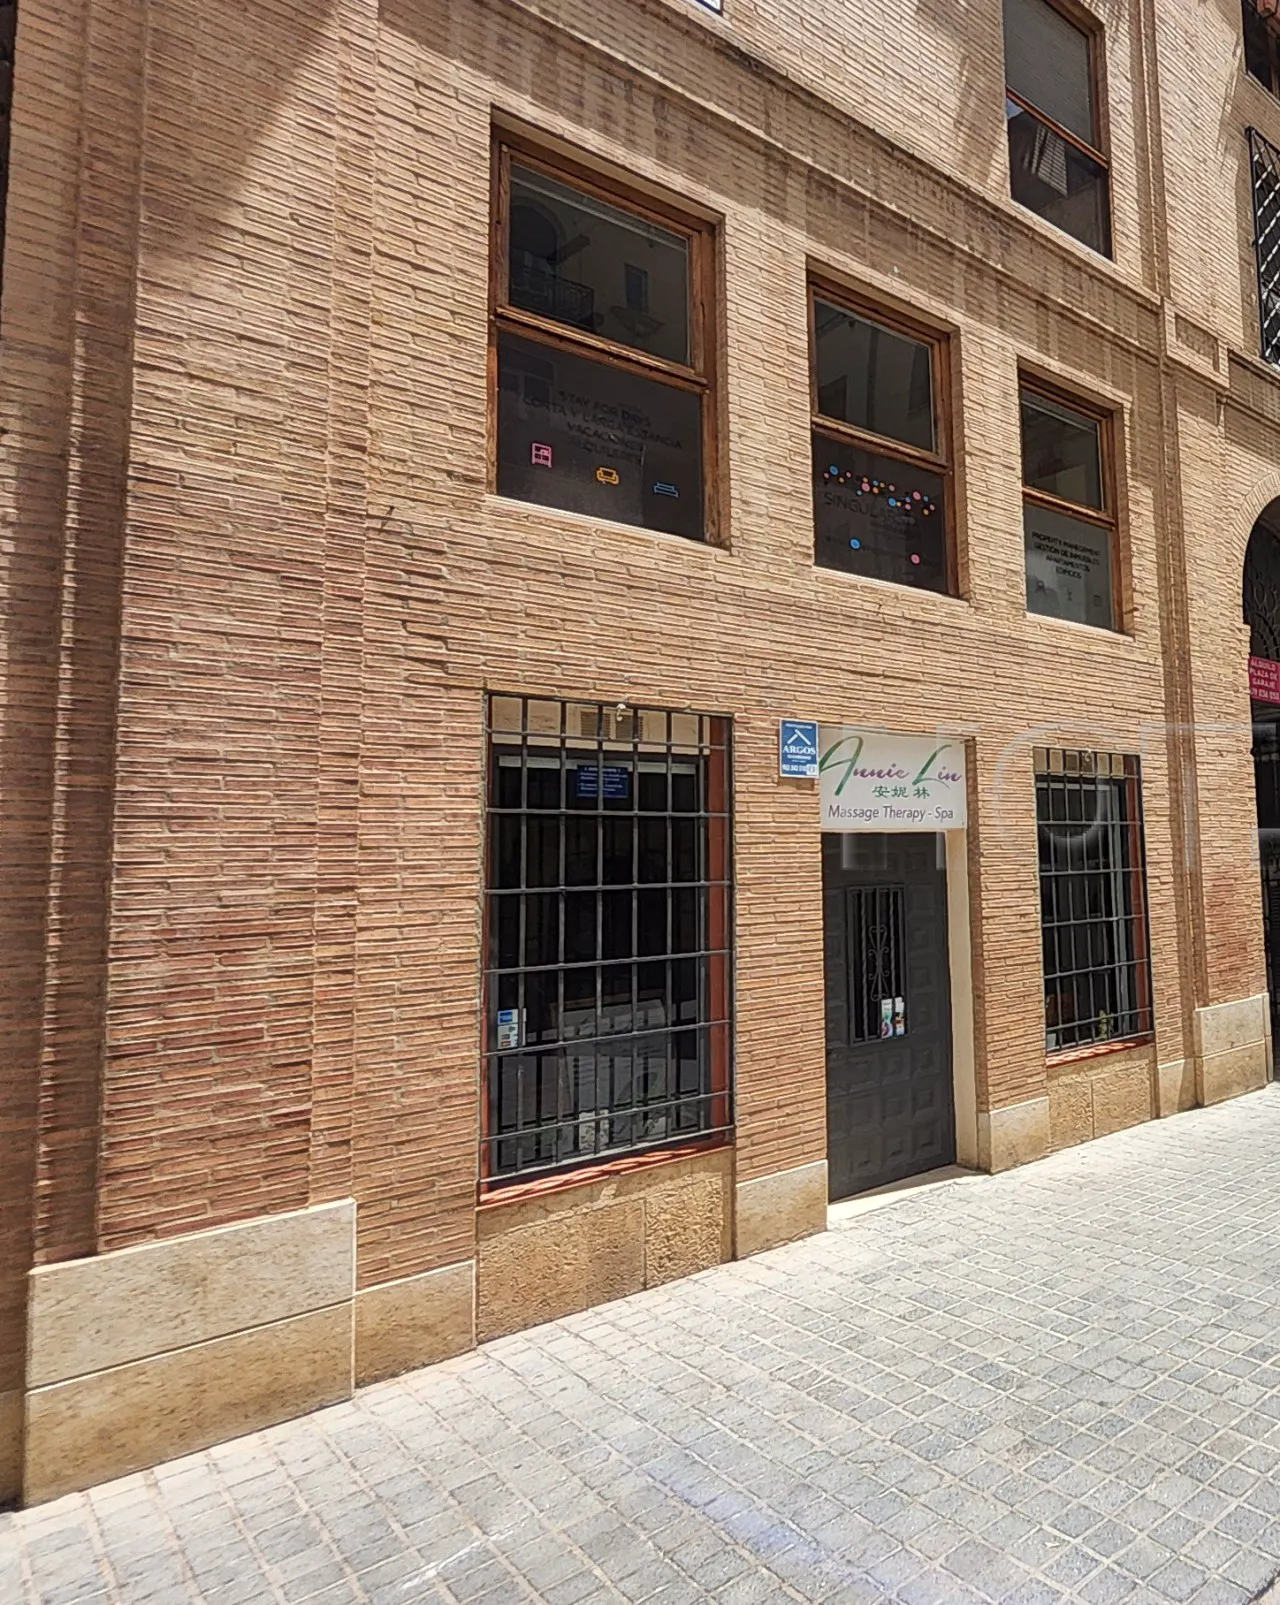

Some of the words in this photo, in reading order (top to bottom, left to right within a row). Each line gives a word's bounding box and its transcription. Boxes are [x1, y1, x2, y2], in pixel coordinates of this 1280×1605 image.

[559, 390, 590, 407] STAY
[595, 400, 619, 416] FOR
[1250, 667, 1270, 678] PLAZA
[782, 745, 816, 755] ARGOS
[819, 735, 910, 796] Annie
[911, 744, 962, 791] Lin
[828, 805, 880, 822] Massage
[883, 805, 926, 823] Therapy
[935, 806, 954, 823] Spa
